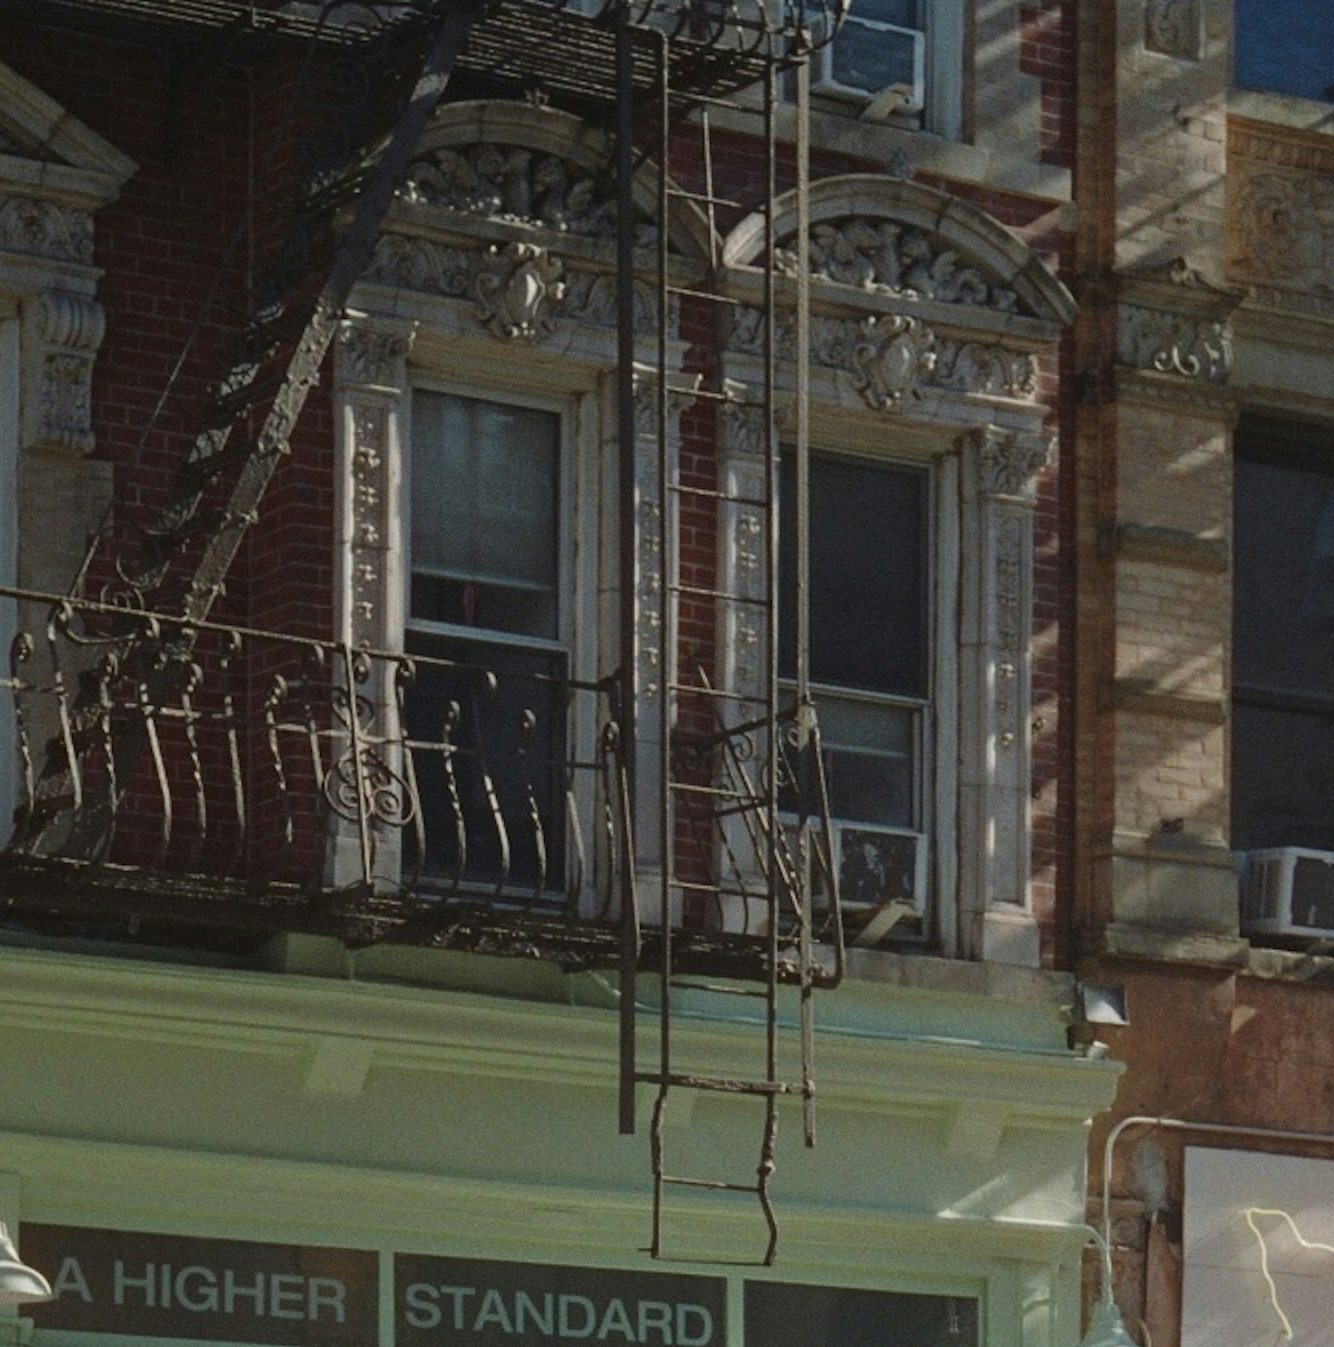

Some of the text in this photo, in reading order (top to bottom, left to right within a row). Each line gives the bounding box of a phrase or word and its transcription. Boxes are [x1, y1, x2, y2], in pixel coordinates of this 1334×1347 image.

[51, 1257, 713, 1347] A HIGHER STANDARD
